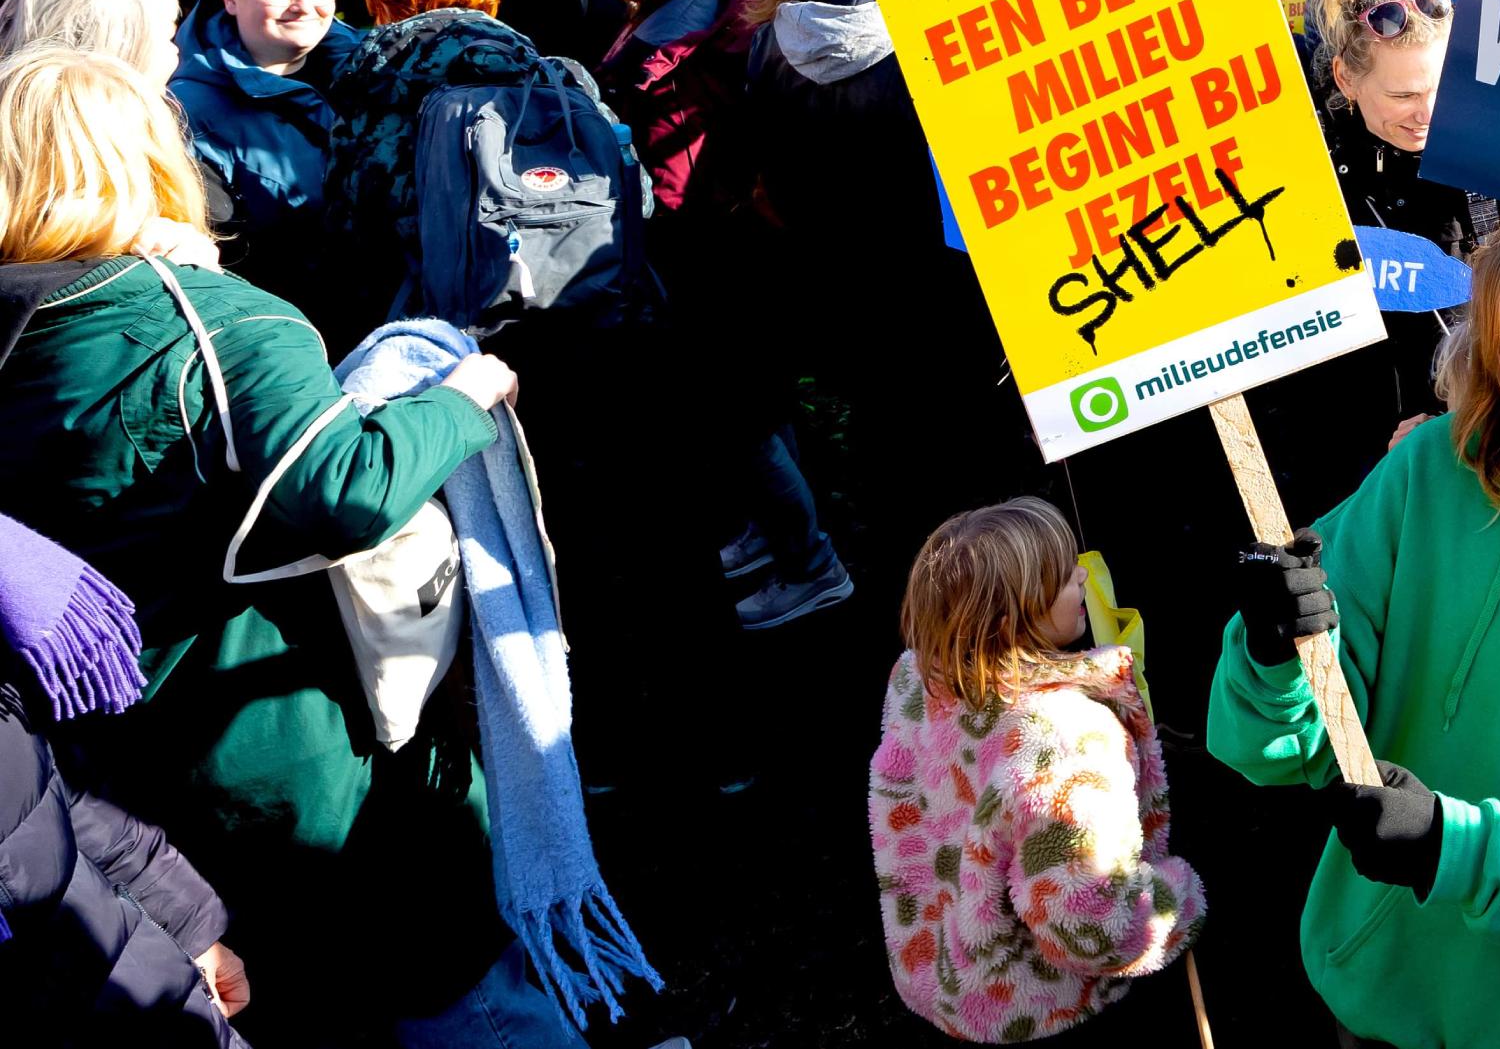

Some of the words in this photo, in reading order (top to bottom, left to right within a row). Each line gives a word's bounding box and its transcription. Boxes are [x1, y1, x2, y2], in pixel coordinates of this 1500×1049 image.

[968, 86, 1179, 230] BEGINT
[1191, 43, 1283, 130] BIJ
[1065, 137, 1244, 270] JEZELF
[1048, 168, 1285, 355] SHELL
[1135, 307, 1342, 401] milieudefensie
